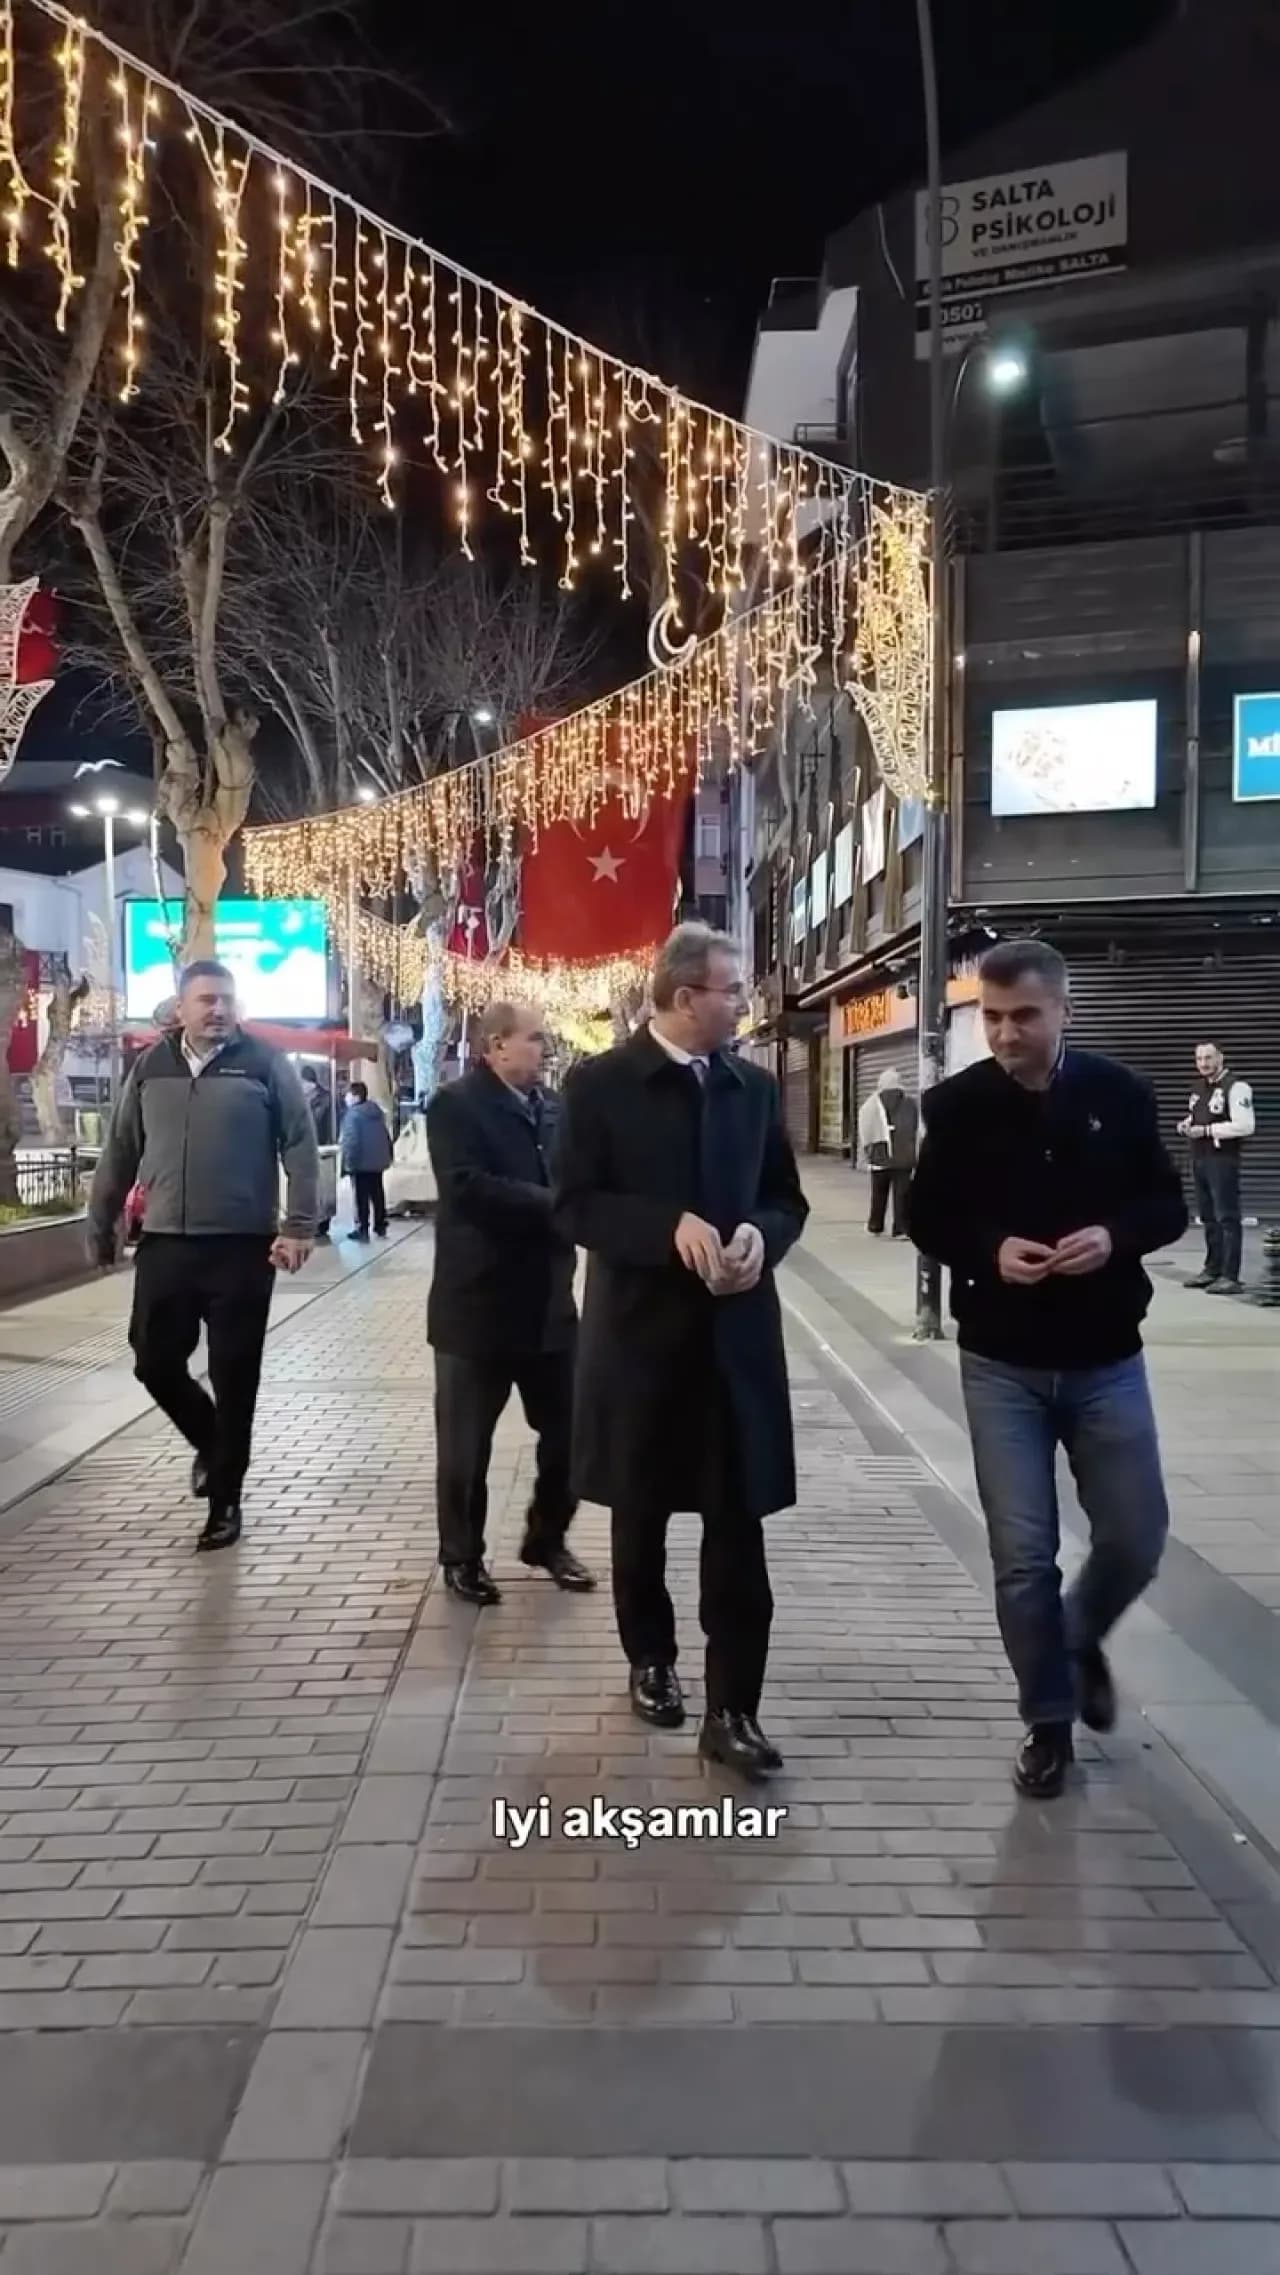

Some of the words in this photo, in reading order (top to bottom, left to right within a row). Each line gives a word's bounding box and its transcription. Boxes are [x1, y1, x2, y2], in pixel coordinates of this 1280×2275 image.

[972, 178, 1055, 211] SALTA
[972, 191, 1115, 244] PSİKOLOJİ
[971, 246, 989, 258] VE
[1058, 253, 1110, 271] SALTA
